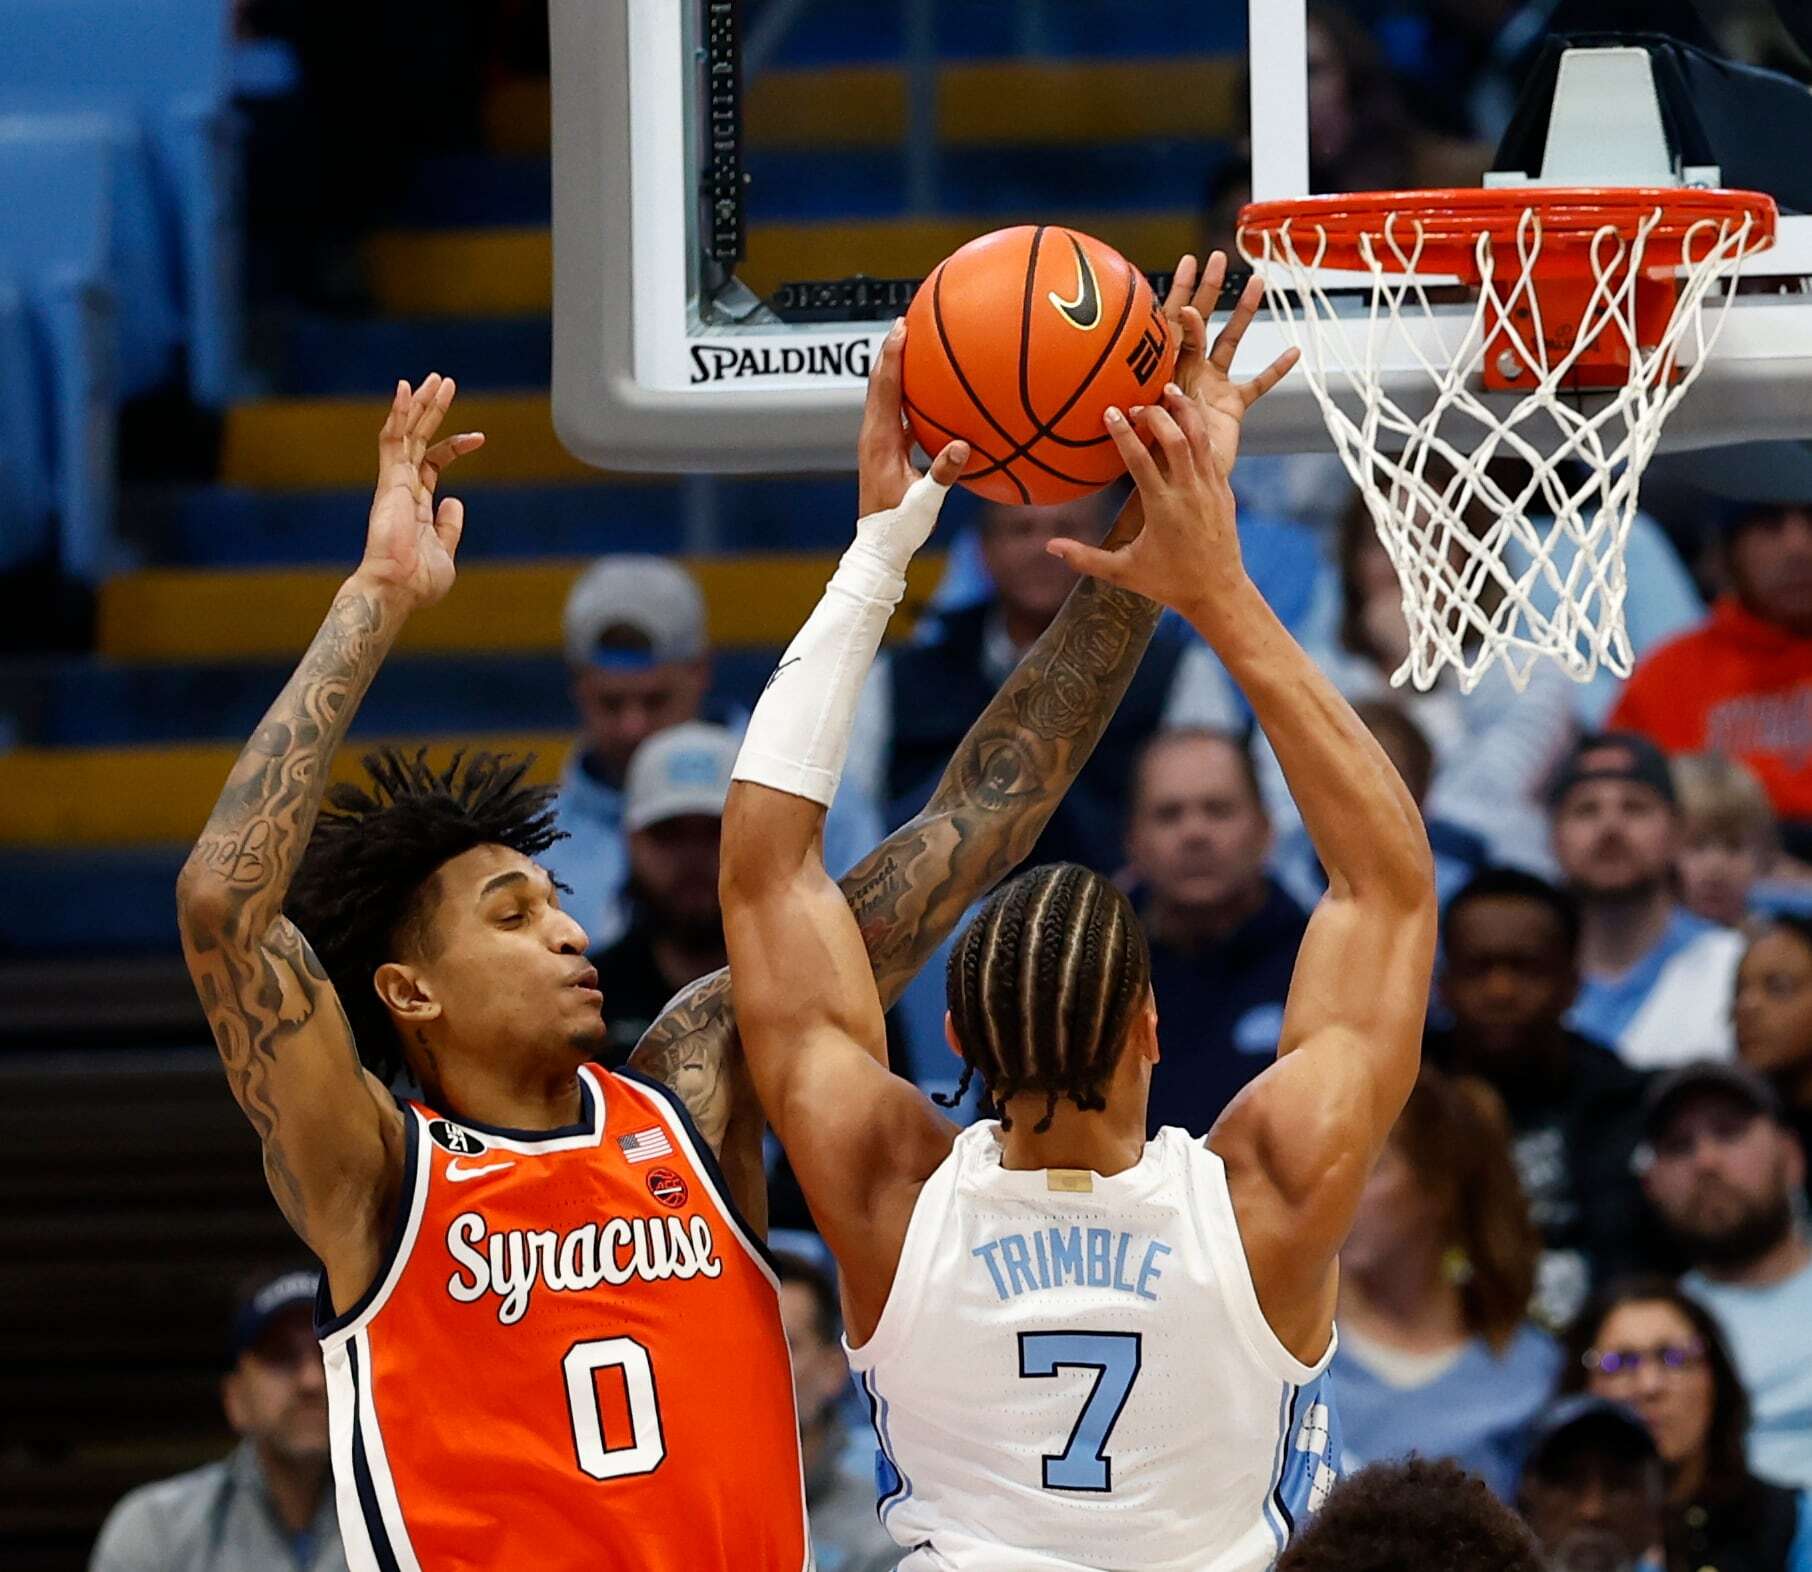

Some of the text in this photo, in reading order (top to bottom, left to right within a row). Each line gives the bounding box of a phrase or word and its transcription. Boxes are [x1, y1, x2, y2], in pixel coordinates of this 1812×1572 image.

[690, 337, 870, 385] SPALDING
[448, 1134, 468, 1152] 21
[446, 1211, 723, 1326] Syracuse
[972, 1226, 1172, 1301] TRIMBLE
[561, 1336, 667, 1480] 0
[1017, 1330, 1142, 1492] 7
